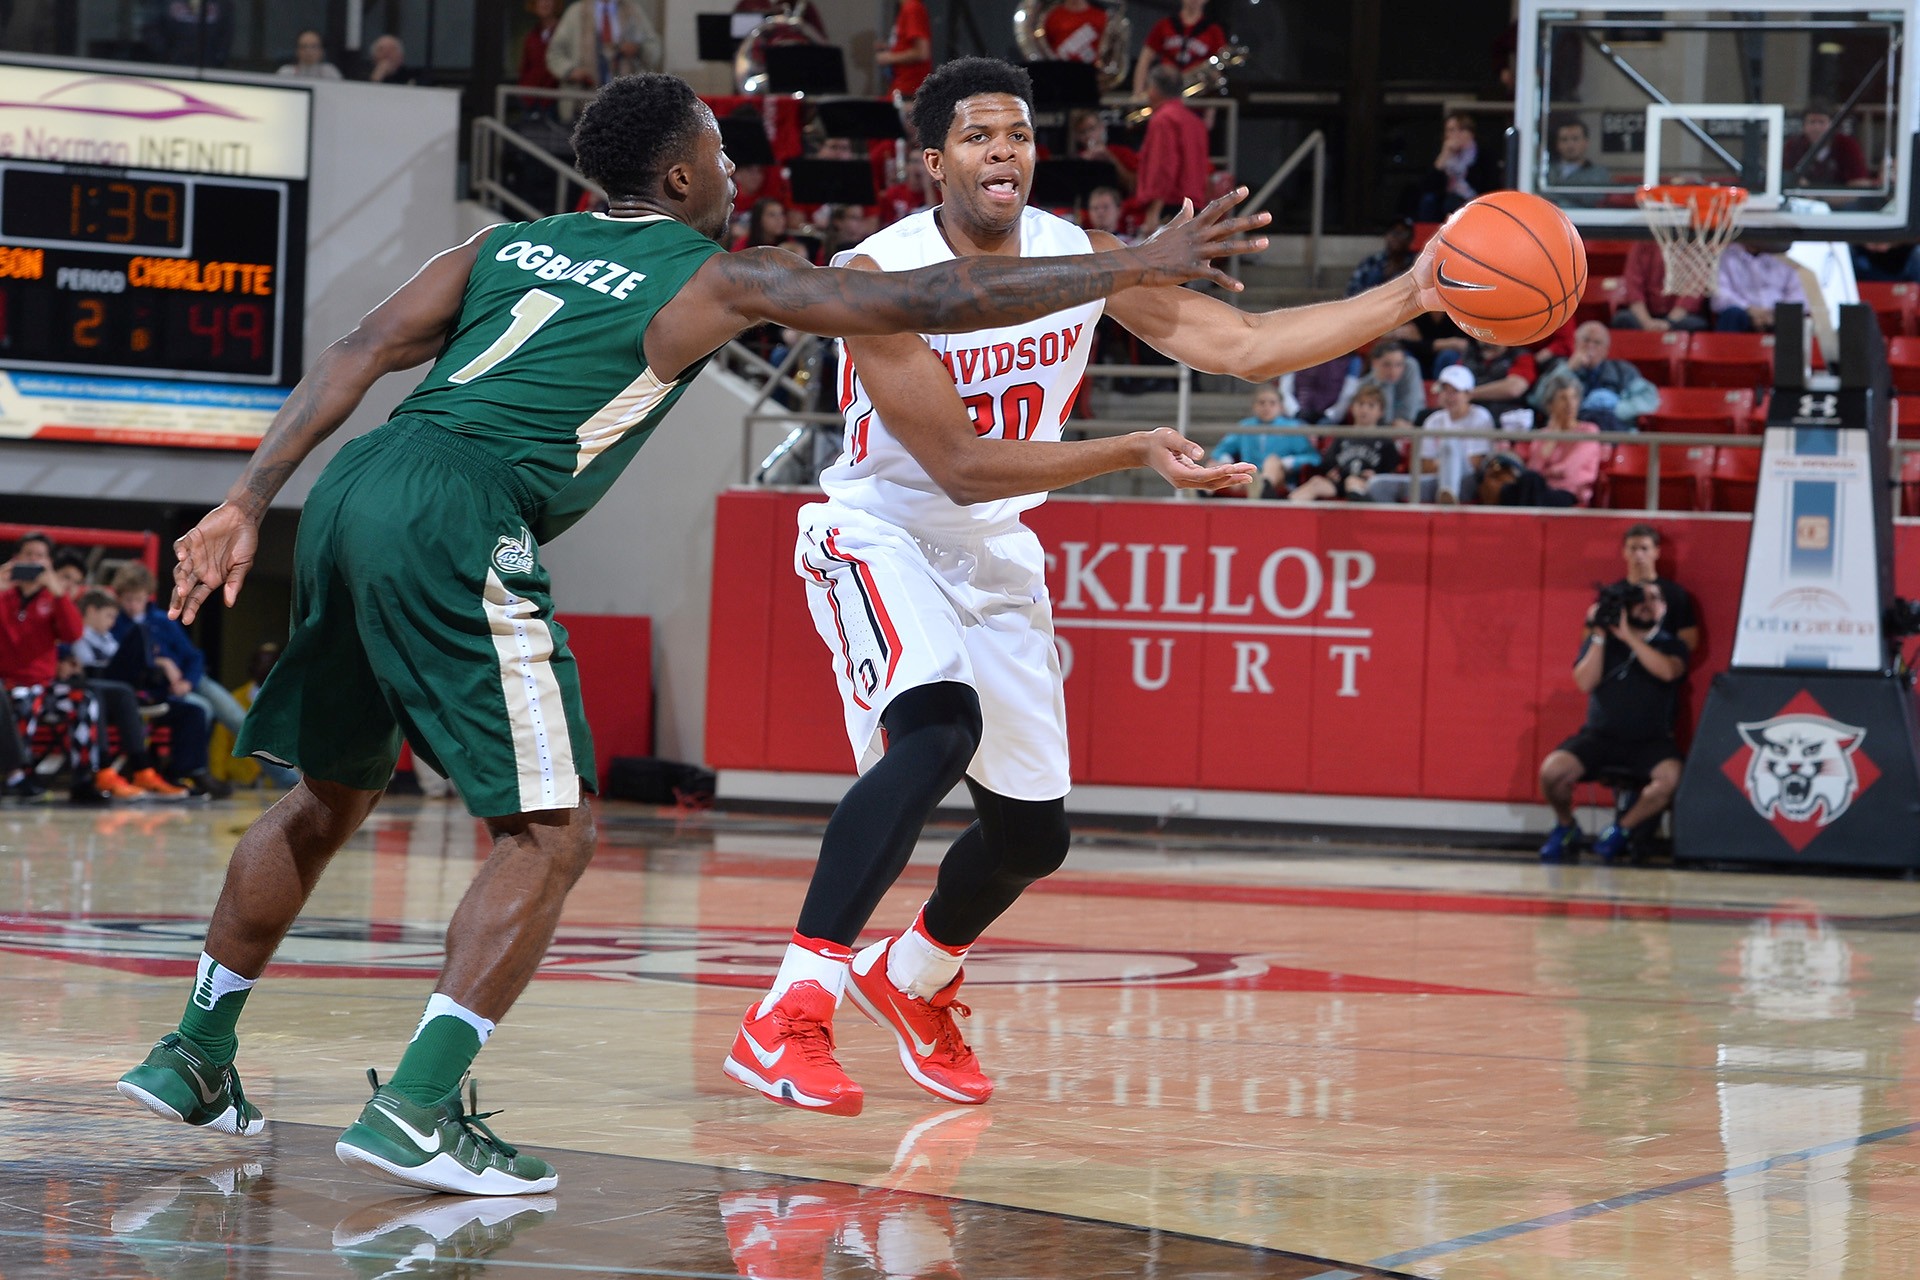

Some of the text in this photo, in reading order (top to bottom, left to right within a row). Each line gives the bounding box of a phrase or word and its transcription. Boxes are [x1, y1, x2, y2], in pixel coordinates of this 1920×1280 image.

[23, 126, 130, 166] Norman
[139, 134, 252, 177] INFINITI
[70, 183, 178, 242] 1:39
[56, 266, 127, 294] PERIOD
[128, 255, 273, 296] CHARLOTTE
[495, 240, 647, 301] OGBUEZE
[73, 299, 105, 348] 2
[188, 303, 264, 359] 49
[448, 287, 565, 385] 1
[931, 323, 1083, 385] AVIDSON
[1045, 541, 1376, 619] KILLOP
